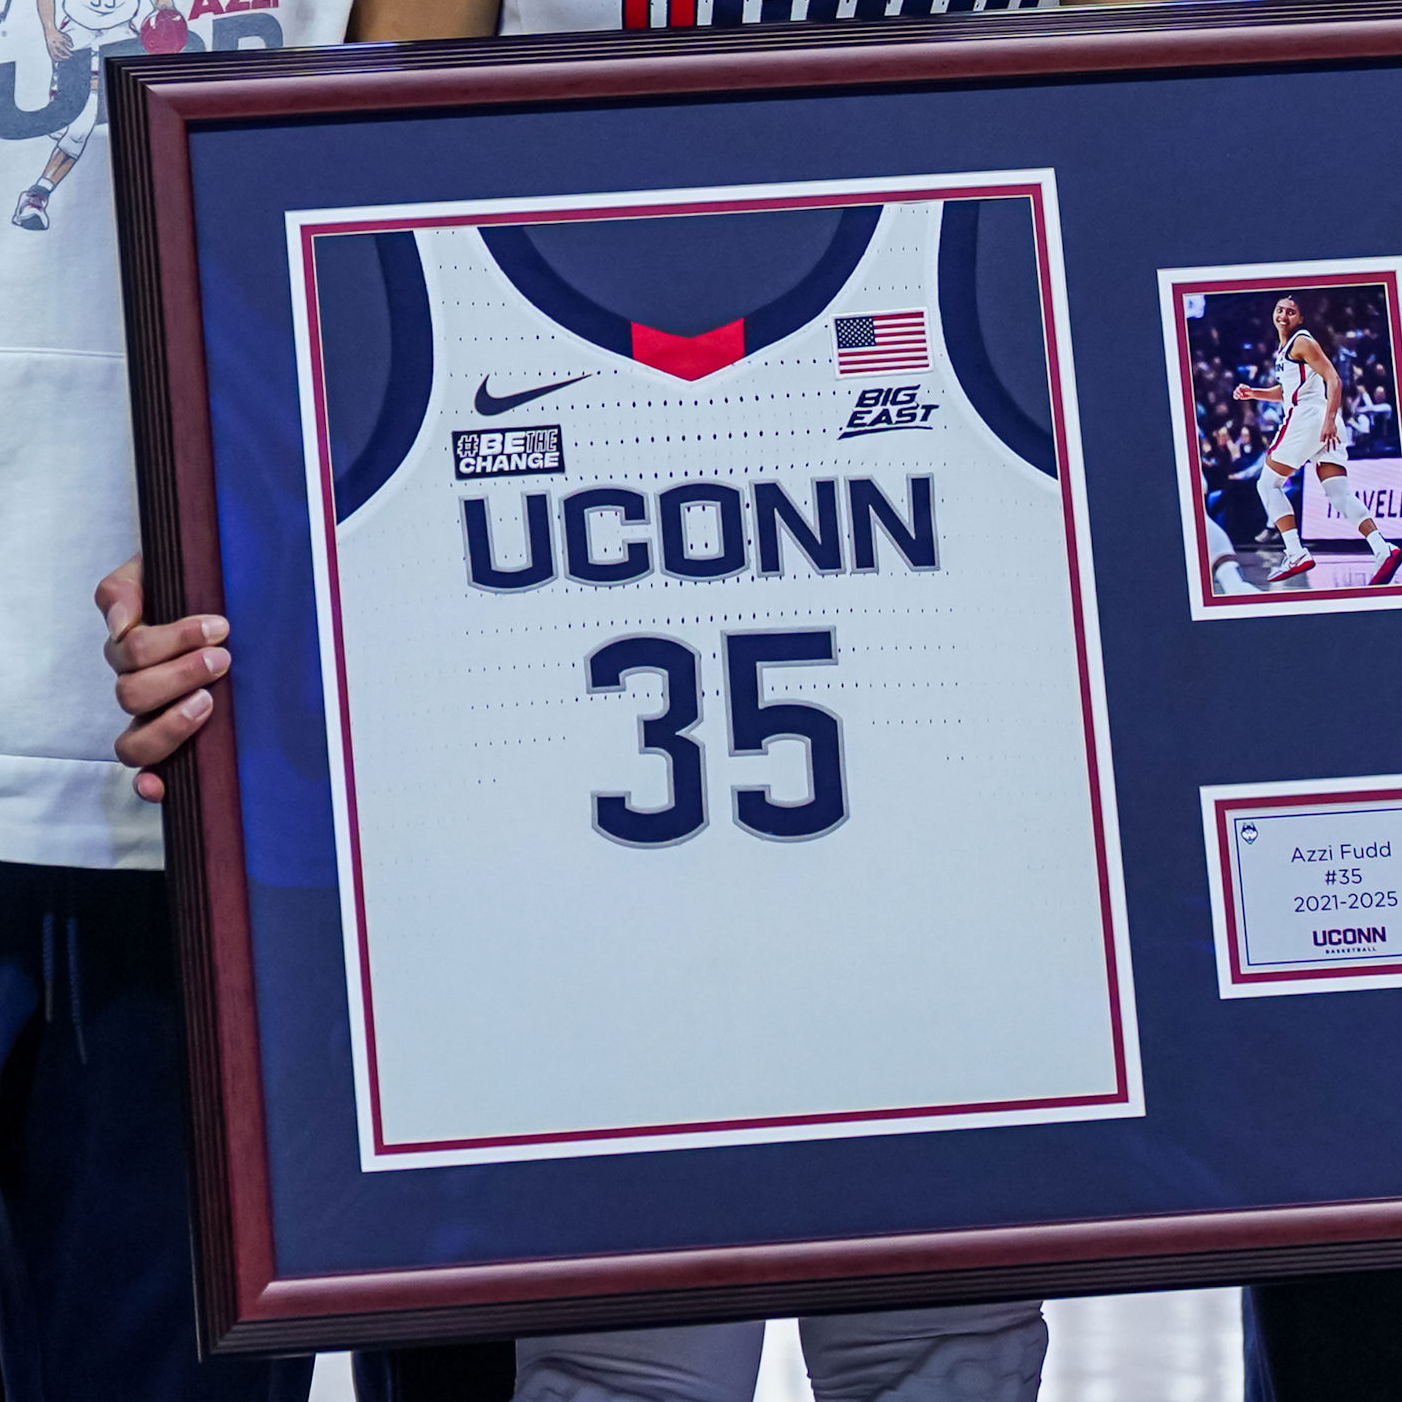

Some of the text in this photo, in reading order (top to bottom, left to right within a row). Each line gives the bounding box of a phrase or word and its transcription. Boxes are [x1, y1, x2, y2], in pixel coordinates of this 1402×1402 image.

[855, 384, 921, 408] BIG
[847, 402, 940, 429] EAST
[459, 452, 560, 474] CHANGE
[458, 472, 941, 595] UCONN
[584, 625, 850, 850] 35
[1291, 841, 1392, 863] Azzi Fudd
[1325, 868, 1363, 886] #35
[1294, 891, 1398, 912] 2021-2025
[1312, 926, 1387, 947] UCONN
